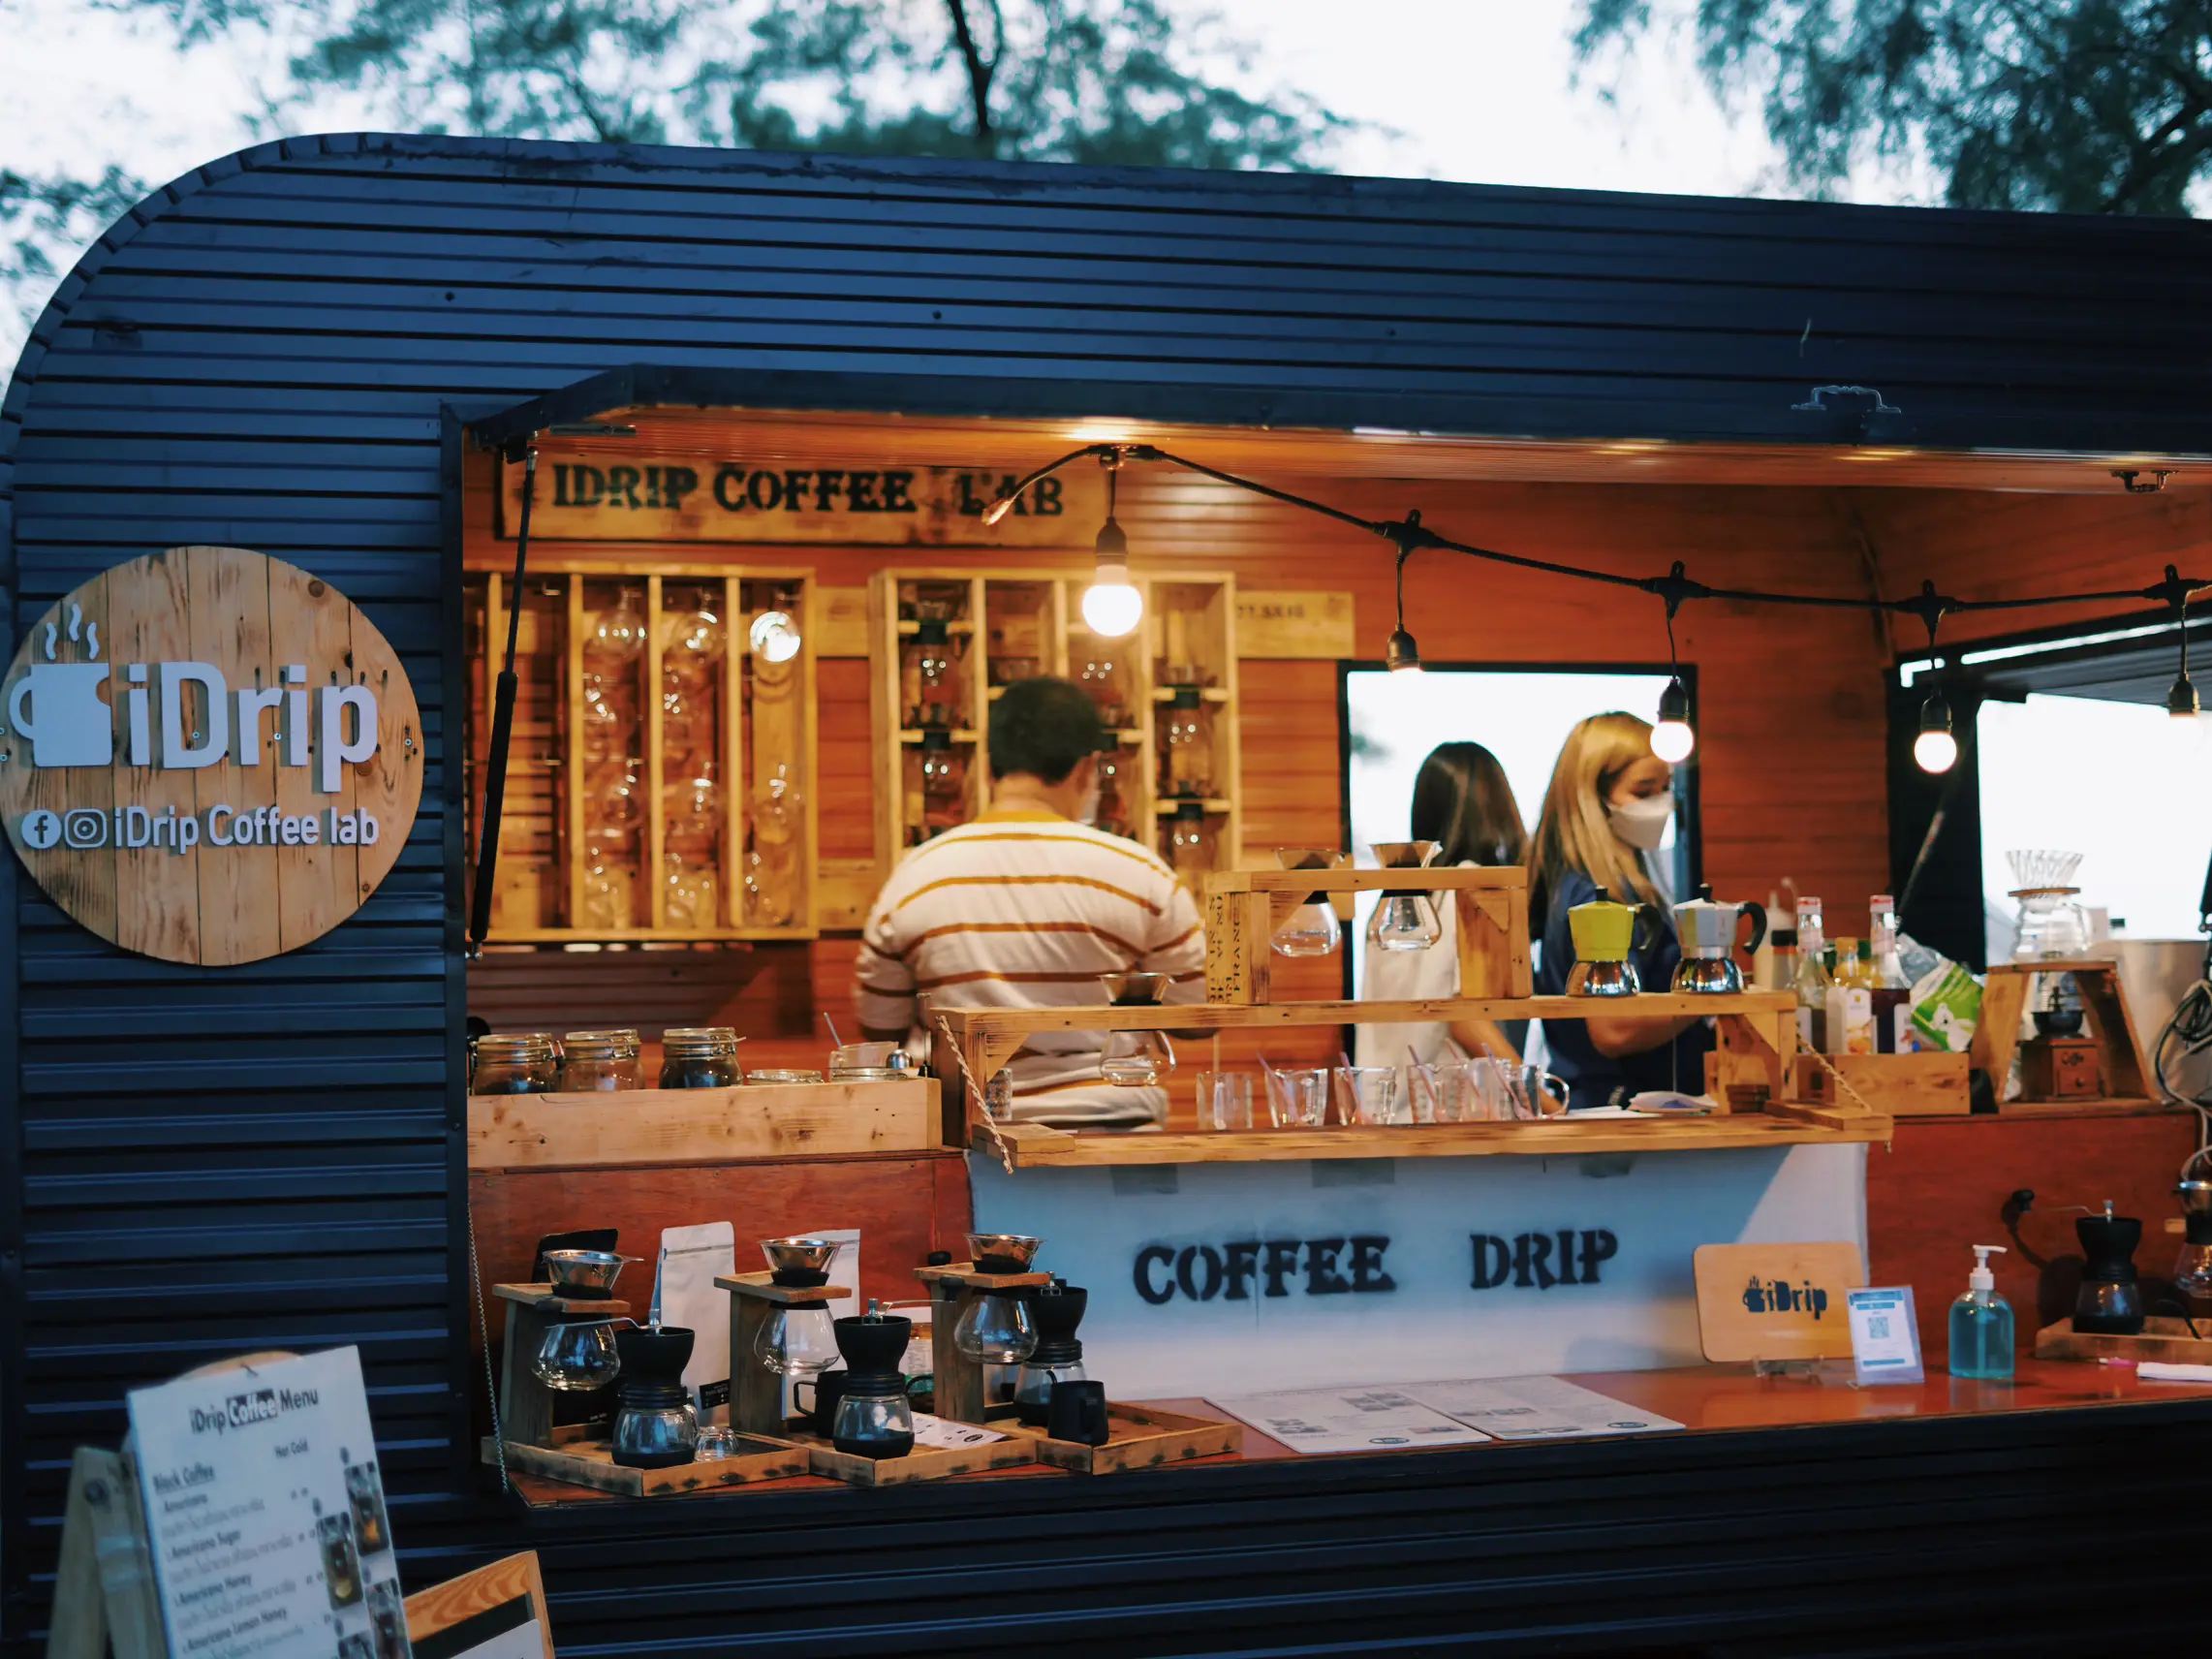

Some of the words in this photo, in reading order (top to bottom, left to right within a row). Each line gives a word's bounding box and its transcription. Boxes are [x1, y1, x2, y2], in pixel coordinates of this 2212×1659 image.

[552, 463, 699, 511] IDRIP
[712, 469, 918, 513] COFFEE
[959, 473, 1064, 516] LAB
[128, 661, 379, 793] iDrip
[115, 806, 199, 855] iDrip
[208, 804, 319, 847] Coffee
[330, 806, 380, 846] lab
[1133, 1235, 1397, 1305] COFFEE
[1470, 1229, 1618, 1290] DRIP
[1766, 1279, 1827, 1321] iDrip
[229, 1393, 278, 1425] Coffee
[279, 1388, 319, 1412] Menu
